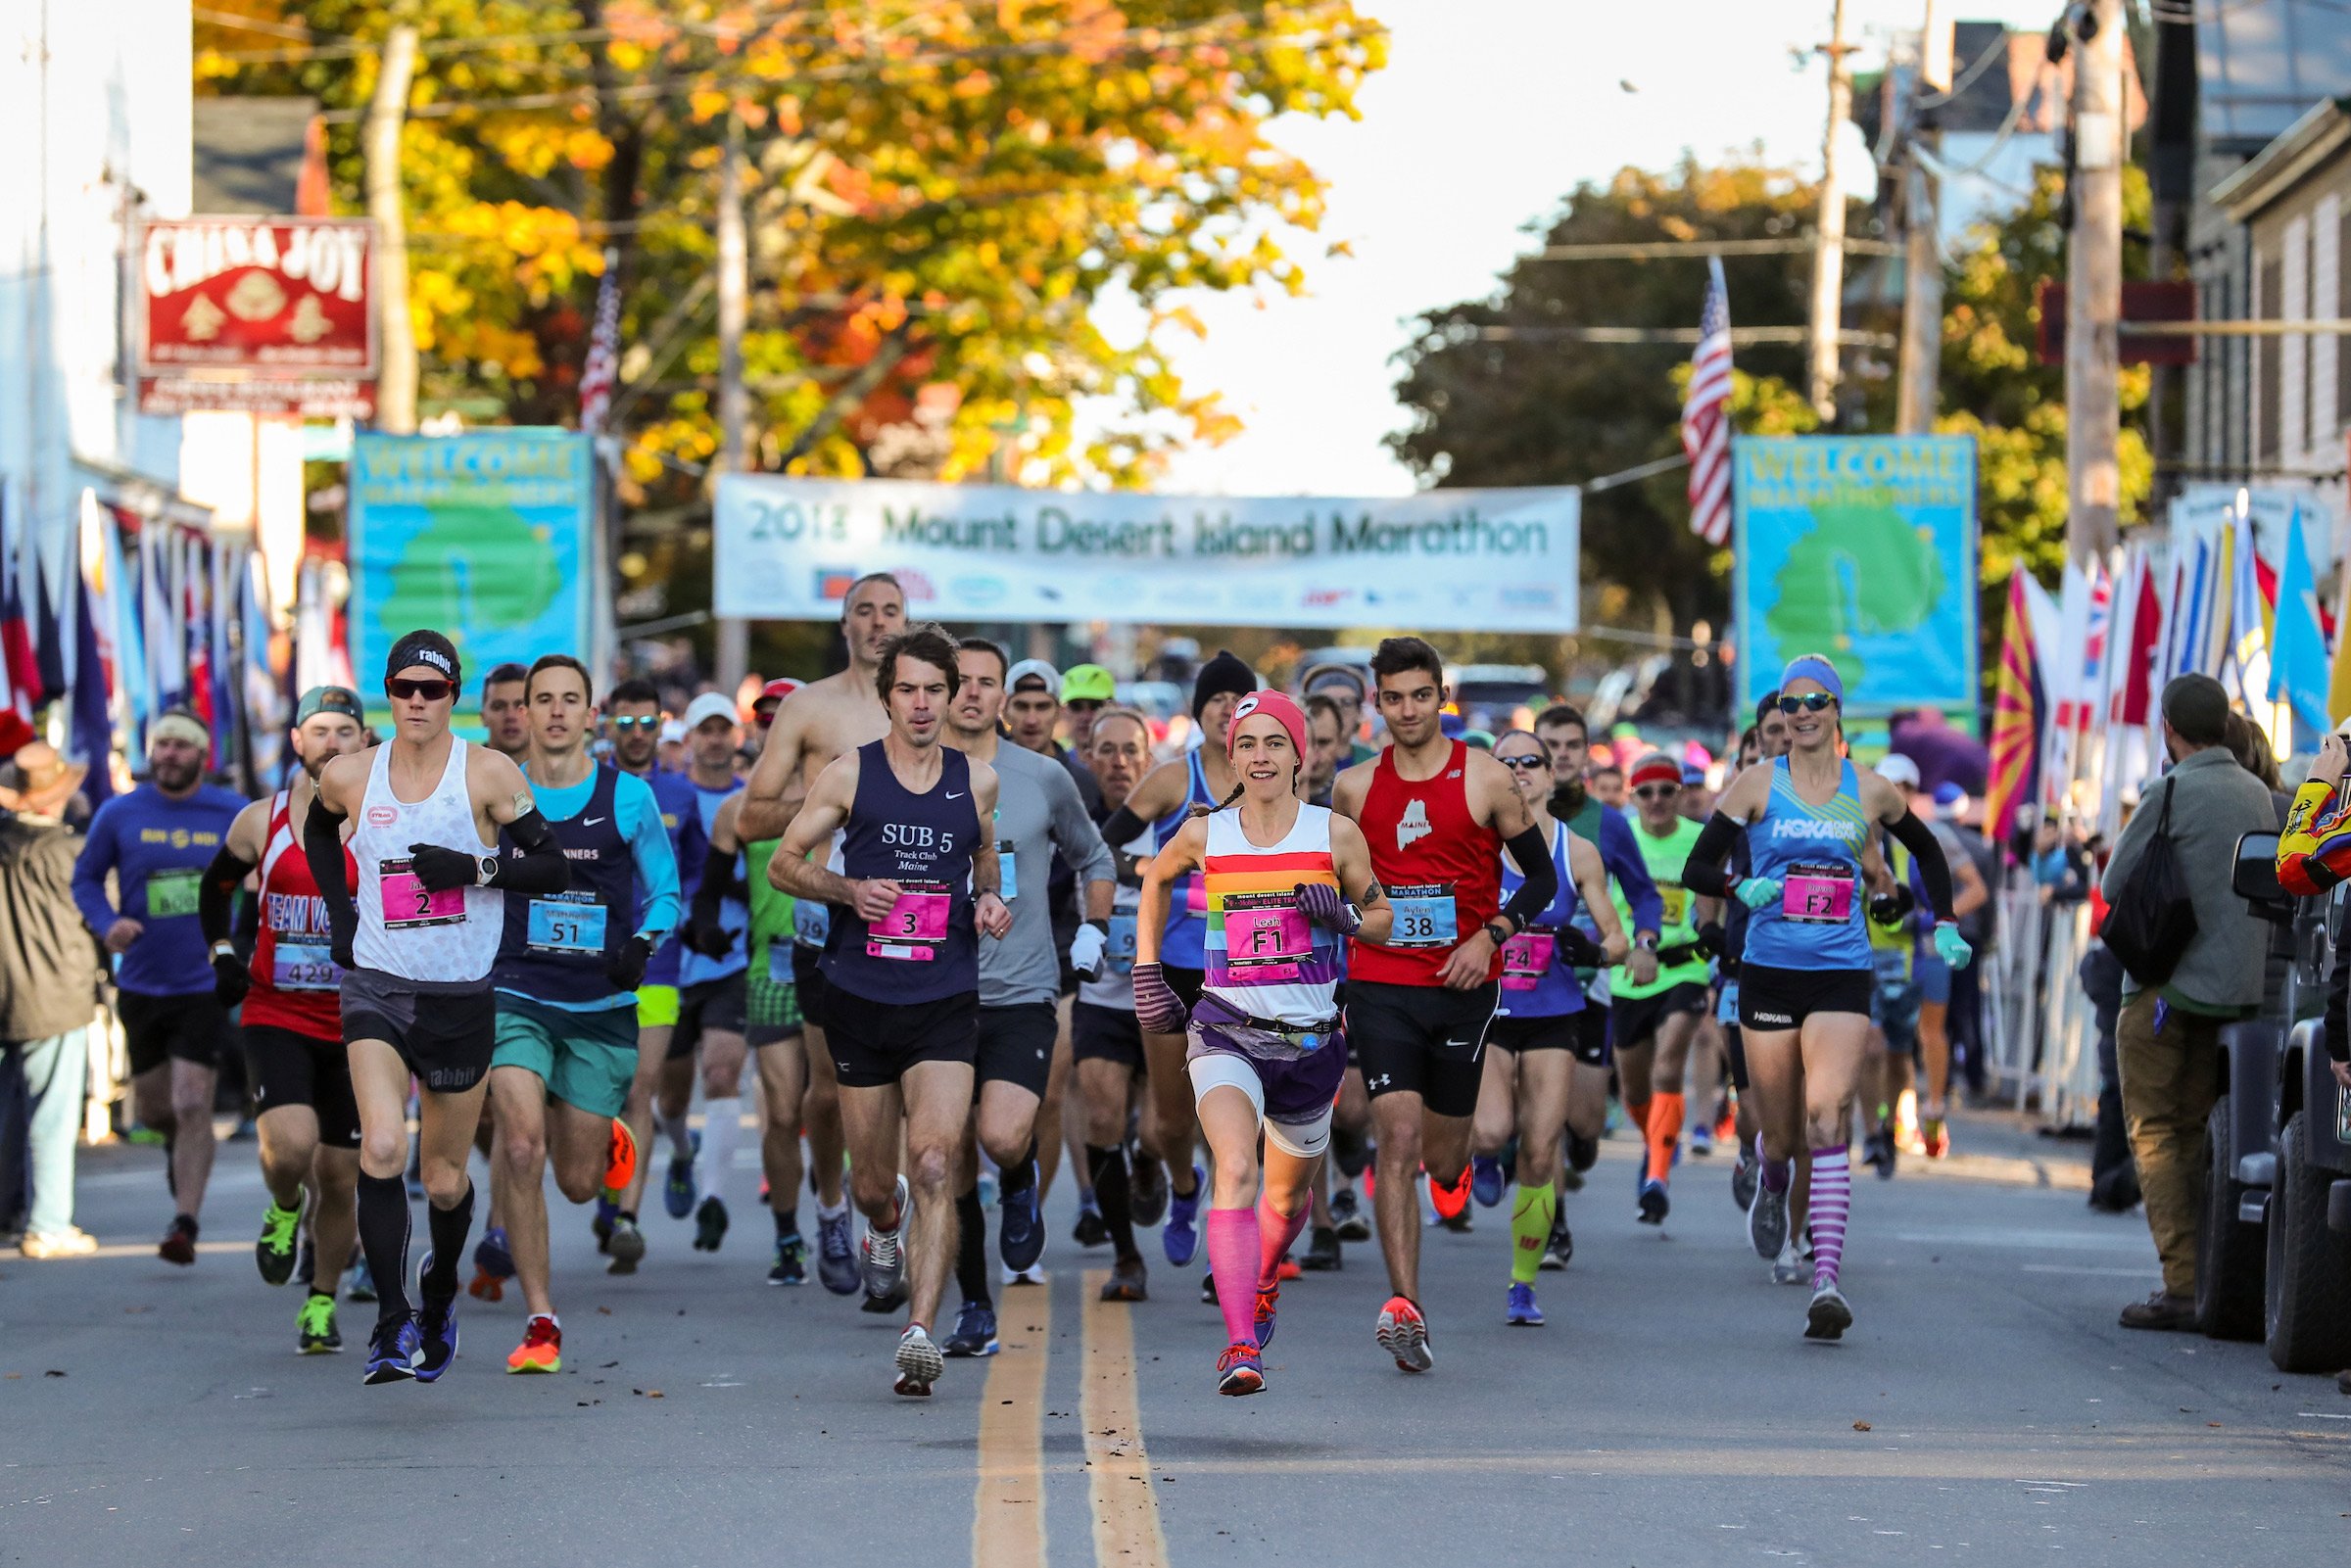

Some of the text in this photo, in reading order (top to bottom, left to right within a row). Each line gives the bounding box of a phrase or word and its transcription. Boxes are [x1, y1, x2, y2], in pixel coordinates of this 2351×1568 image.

[281, 225, 366, 303] JOY
[1751, 443, 1959, 480] WELCOME
[882, 504, 1019, 550] Mount
[1036, 505, 1175, 555] Desert
[1193, 507, 1316, 556] Island
[1329, 507, 1549, 556] Marathon
[418, 648, 452, 675] rabbit
[1771, 818, 1835, 838] HOKA
[882, 823, 954, 854] SUB 5
[893, 849, 938, 862] Track Club
[897, 860, 930, 873] Maine
[1390, 887, 1442, 897] MARATHON
[266, 892, 309, 932] TEAM
[414, 893, 432, 916] 2
[1403, 905, 1432, 917] Aylen
[1805, 894, 1834, 915] F2
[901, 913, 917, 934] 3
[1254, 917, 1281, 927] Leah
[1403, 917, 1434, 937] 38
[551, 923, 579, 943] 51
[1252, 929, 1282, 953] F1
[1504, 949, 1530, 968] F4
[287, 963, 334, 983] 429
[1753, 1011, 1782, 1024] HOKA
